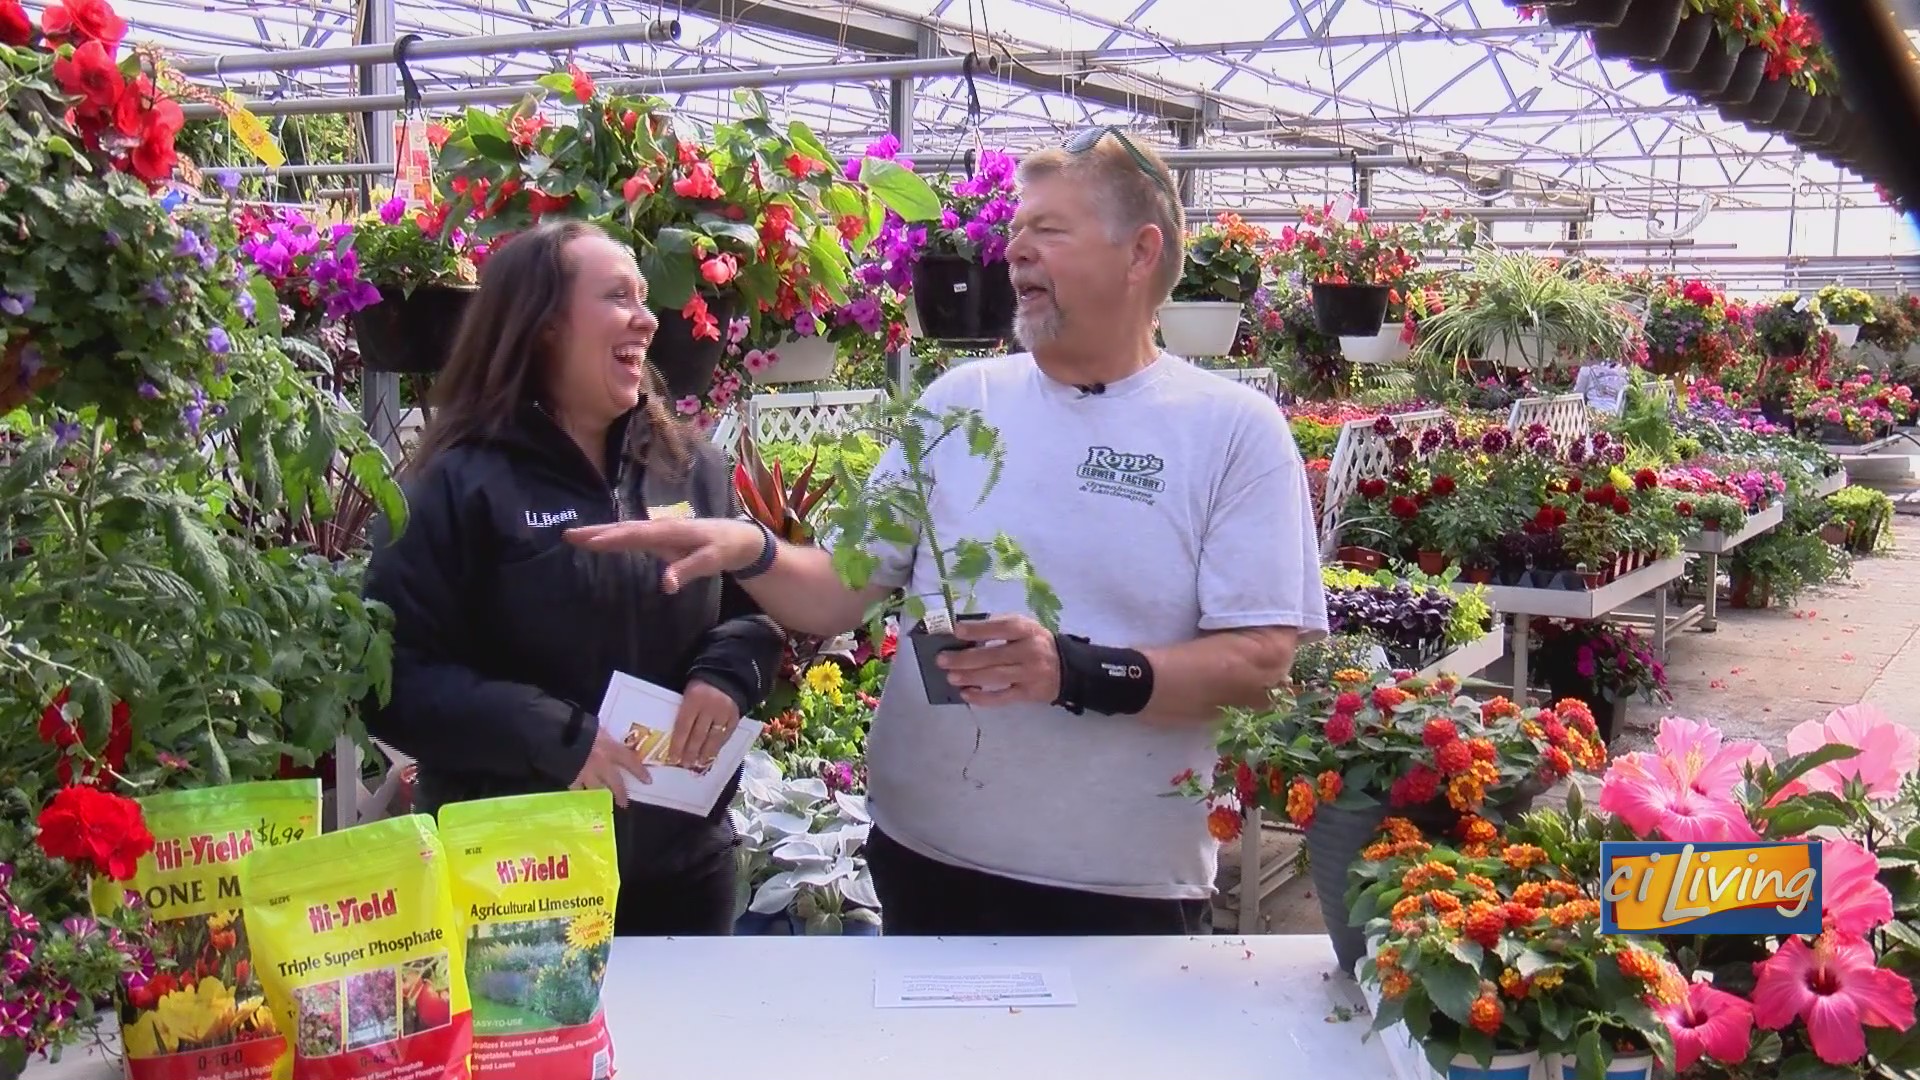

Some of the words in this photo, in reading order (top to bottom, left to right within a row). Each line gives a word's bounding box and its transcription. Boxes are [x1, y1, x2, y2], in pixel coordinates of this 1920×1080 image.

[1080, 467, 1116, 481] FLOWER
[1120, 473, 1161, 490] FACTORY
[155, 829, 255, 872] Hi-Yield
[496, 854, 570, 885] Hi-Yield
[144, 879, 206, 910] ONE
[308, 888, 398, 934] Hi-Yield
[470, 899, 536, 921] Agricultural
[539, 895, 605, 912] Limestone
[575, 919, 605, 935] Dolomite
[583, 930, 601, 940] Lime
[278, 955, 322, 978] Triple
[324, 947, 365, 967] Super
[368, 927, 444, 957] Phosphate
[472, 1017, 524, 1028] EASY-TO-USE
[500, 1040, 523, 1049] Excess
[523, 1037, 537, 1046] Soil
[393, 1060, 424, 1075] Phosphate
[415, 1064, 445, 1078] Phosphate
